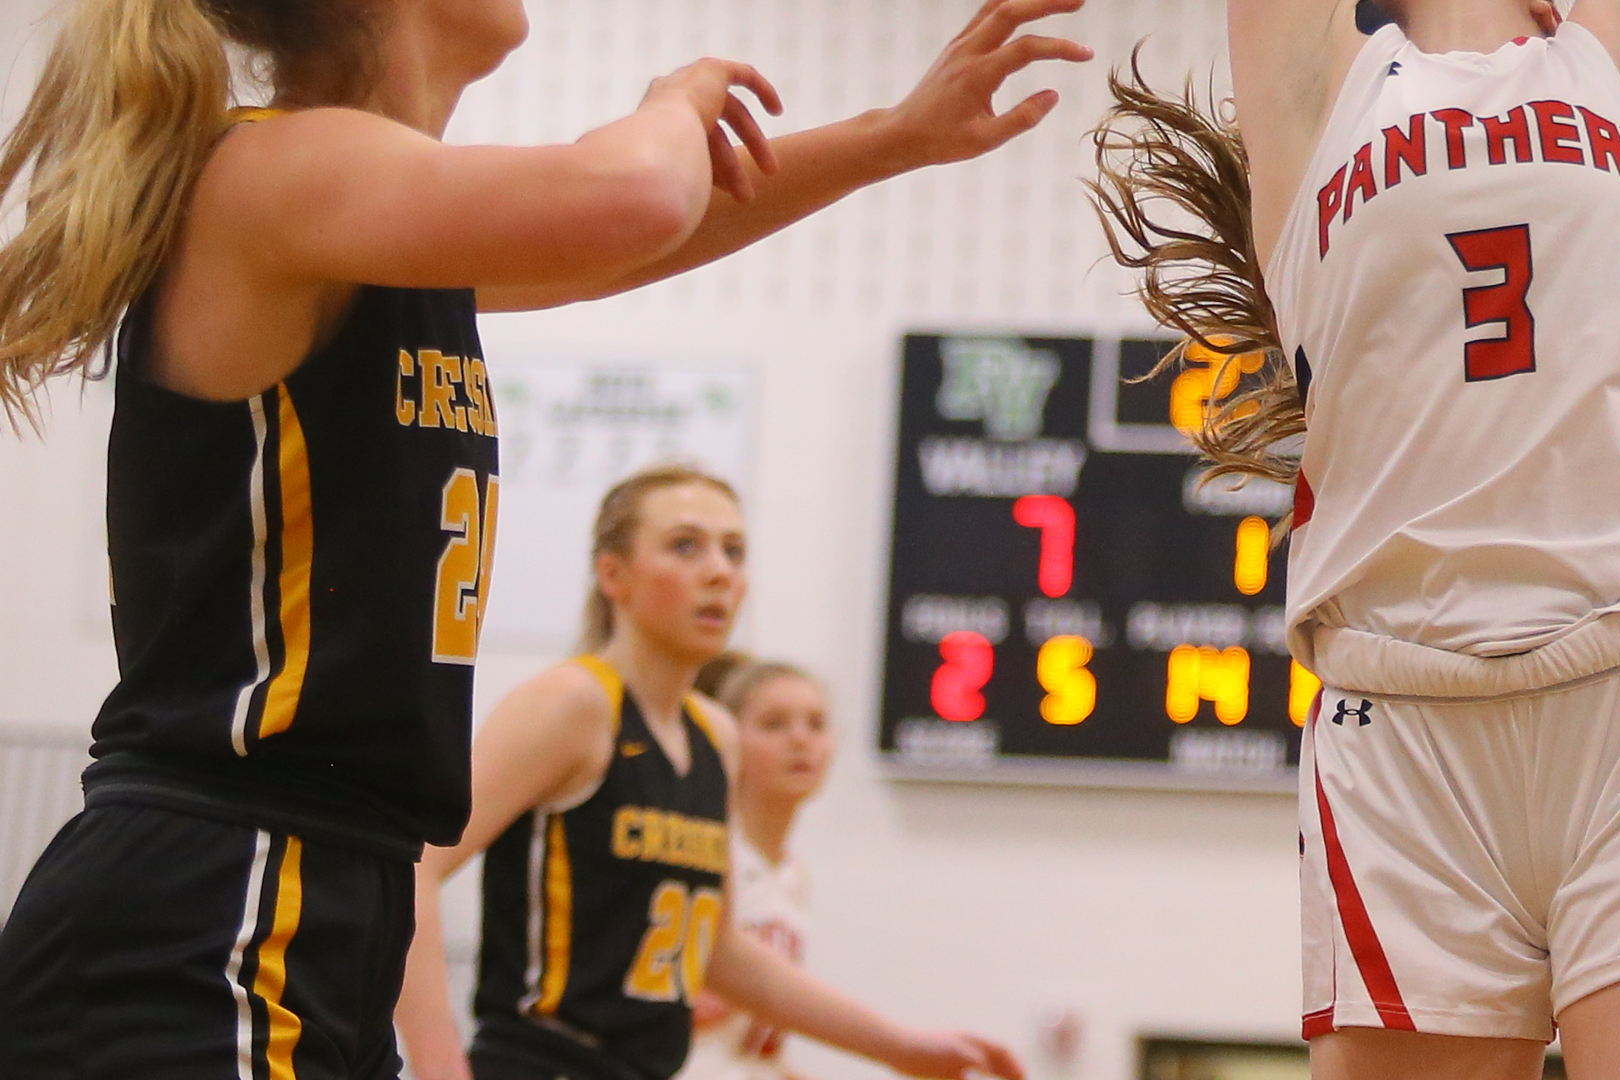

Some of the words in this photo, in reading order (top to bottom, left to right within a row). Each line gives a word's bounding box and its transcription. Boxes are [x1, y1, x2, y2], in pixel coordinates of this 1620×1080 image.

[1444, 222, 1537, 384] 3
[1012, 494, 1076, 598] 7
[930, 630, 995, 722] 2
[1036, 634, 1097, 726] 5
[622, 878, 722, 1009] 20
